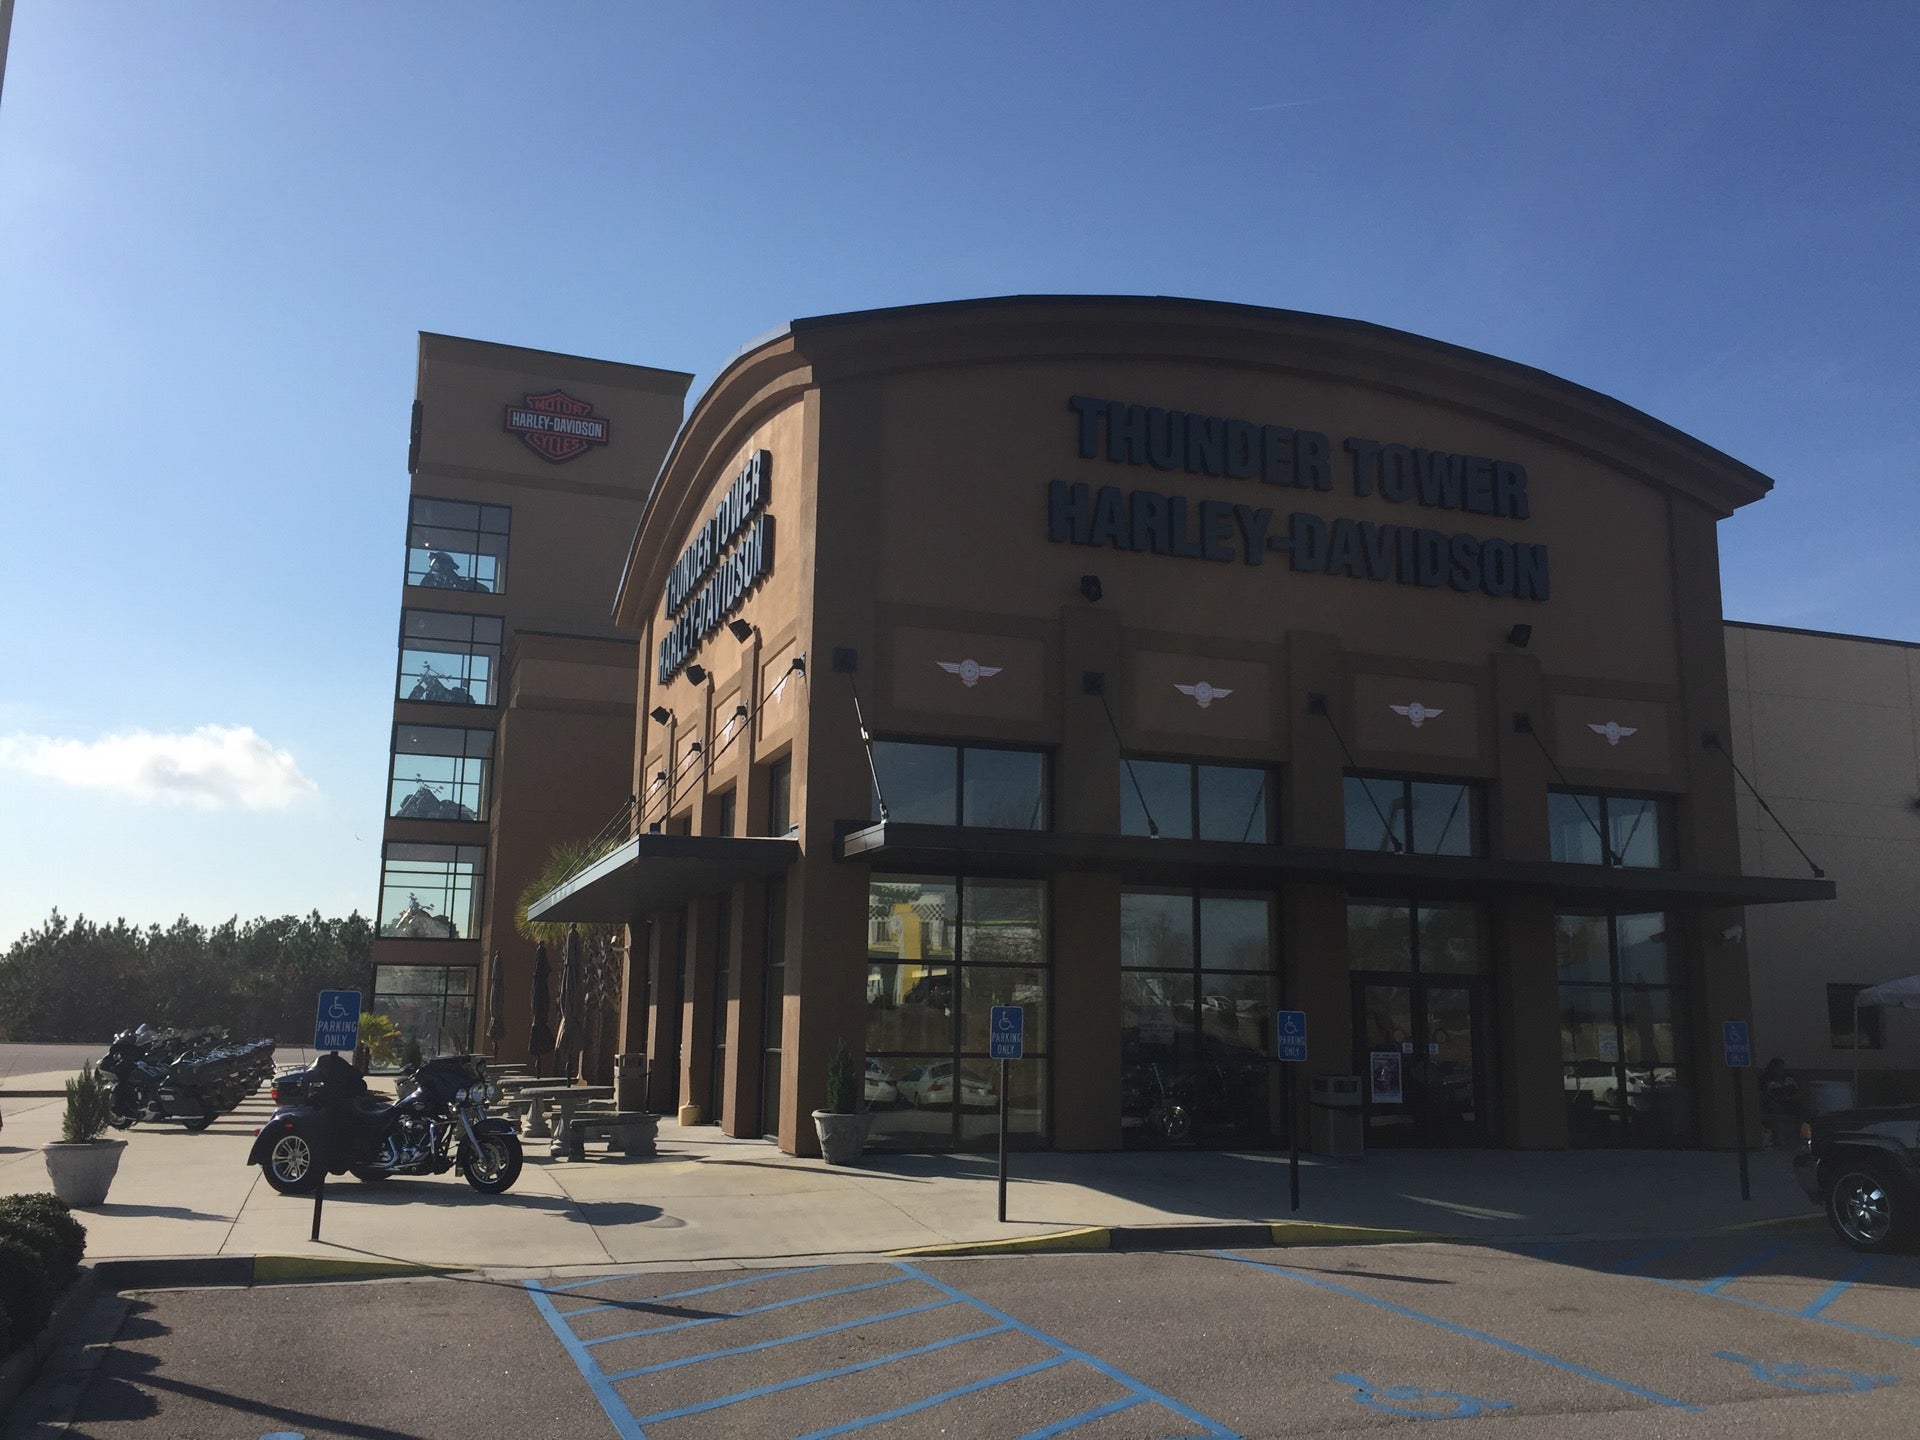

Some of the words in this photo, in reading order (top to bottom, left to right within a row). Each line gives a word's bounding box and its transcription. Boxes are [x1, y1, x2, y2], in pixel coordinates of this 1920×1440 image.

[534, 397, 583, 416] MOTOR
[512, 411, 602, 438] HARLEY-DAVIDSON
[532, 433, 580, 455] CYCLES
[1070, 395, 1332, 491] THUNDER
[1343, 437, 1530, 520] TOWER
[665, 519, 716, 620] THUNDER
[715, 449, 772, 554] TOWER
[1048, 480, 1550, 600] HARLEY-DAVIDSON
[658, 514, 775, 685] HARLEY-DAVIDSON
[317, 1020, 357, 1032] PARKING
[324, 1034, 347, 1046] ONLY
